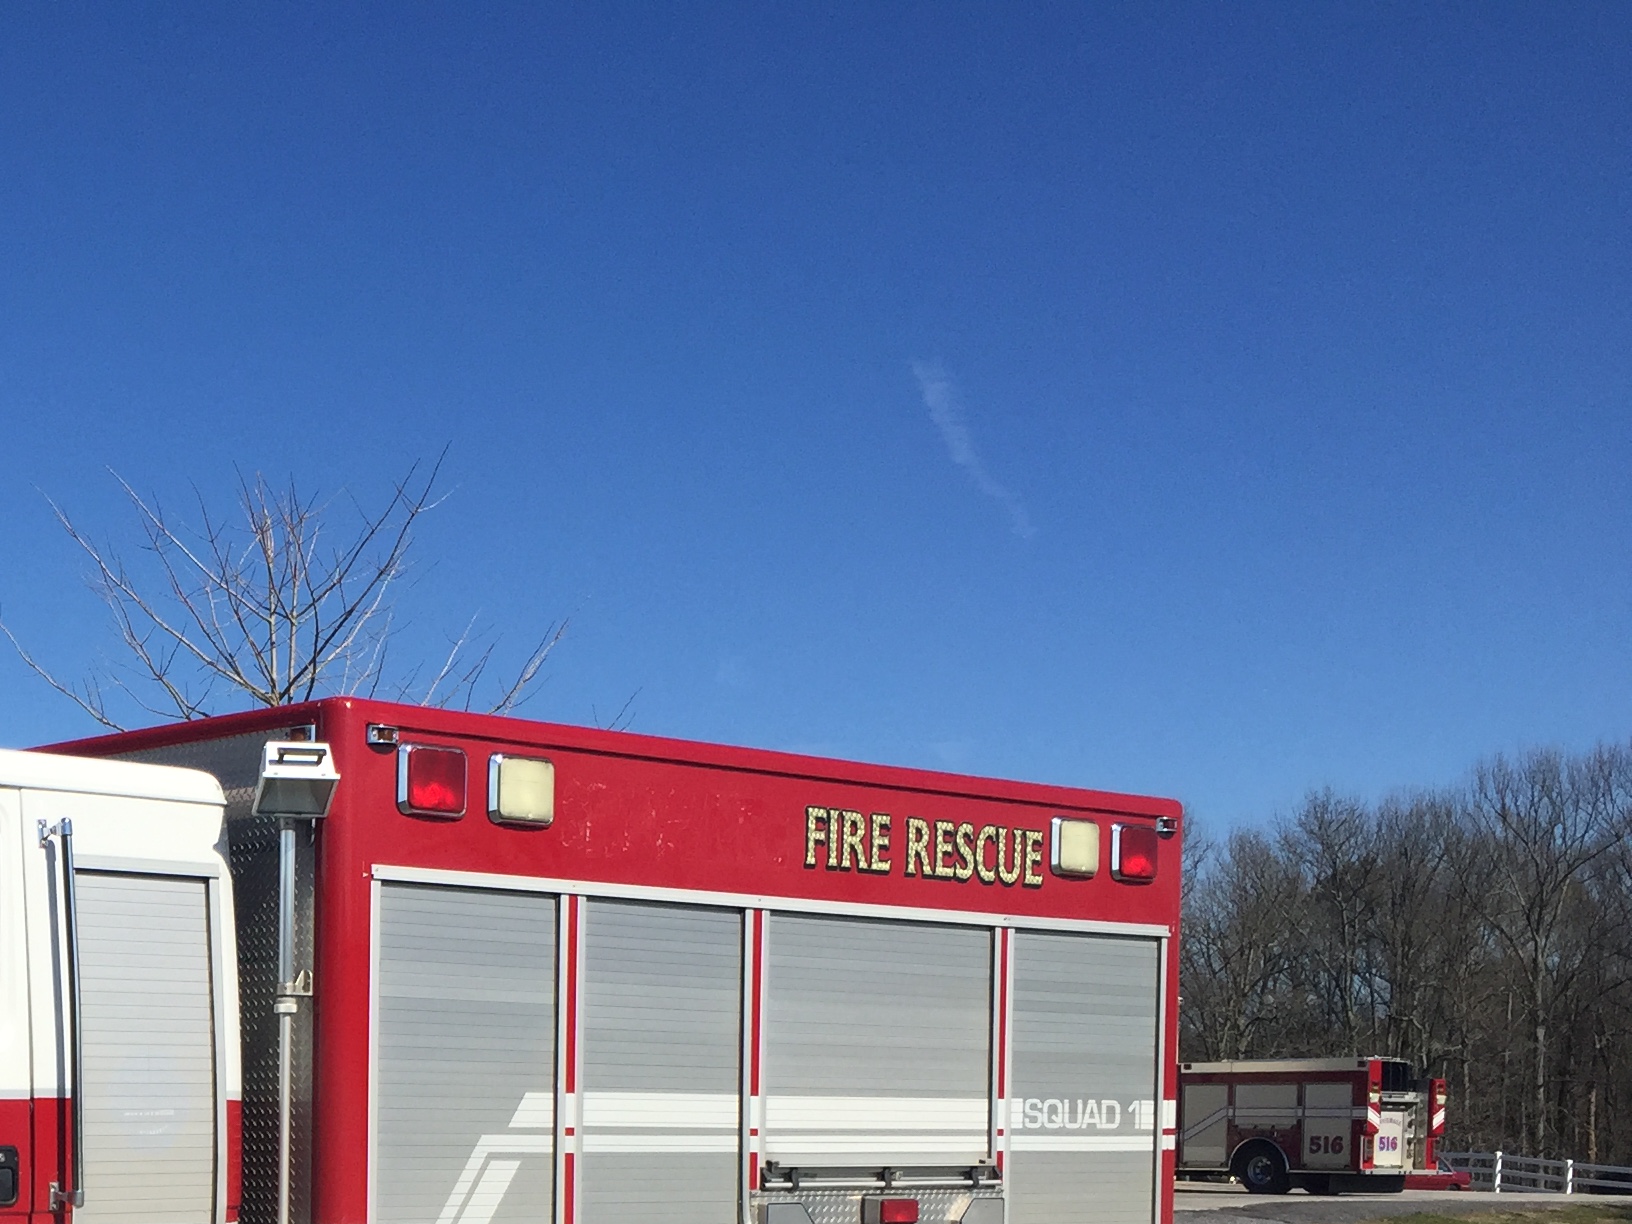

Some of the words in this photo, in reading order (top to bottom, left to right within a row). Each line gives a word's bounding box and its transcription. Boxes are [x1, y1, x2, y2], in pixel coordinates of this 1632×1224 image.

[805, 806, 891, 872] FIRE
[905, 817, 1044, 887] RESCUE
[1024, 1098, 1121, 1129] SQUAD
[1128, 1100, 1140, 1129] 1
[1309, 1135, 1344, 1154] 516
[1378, 1136, 1398, 1151] 516
